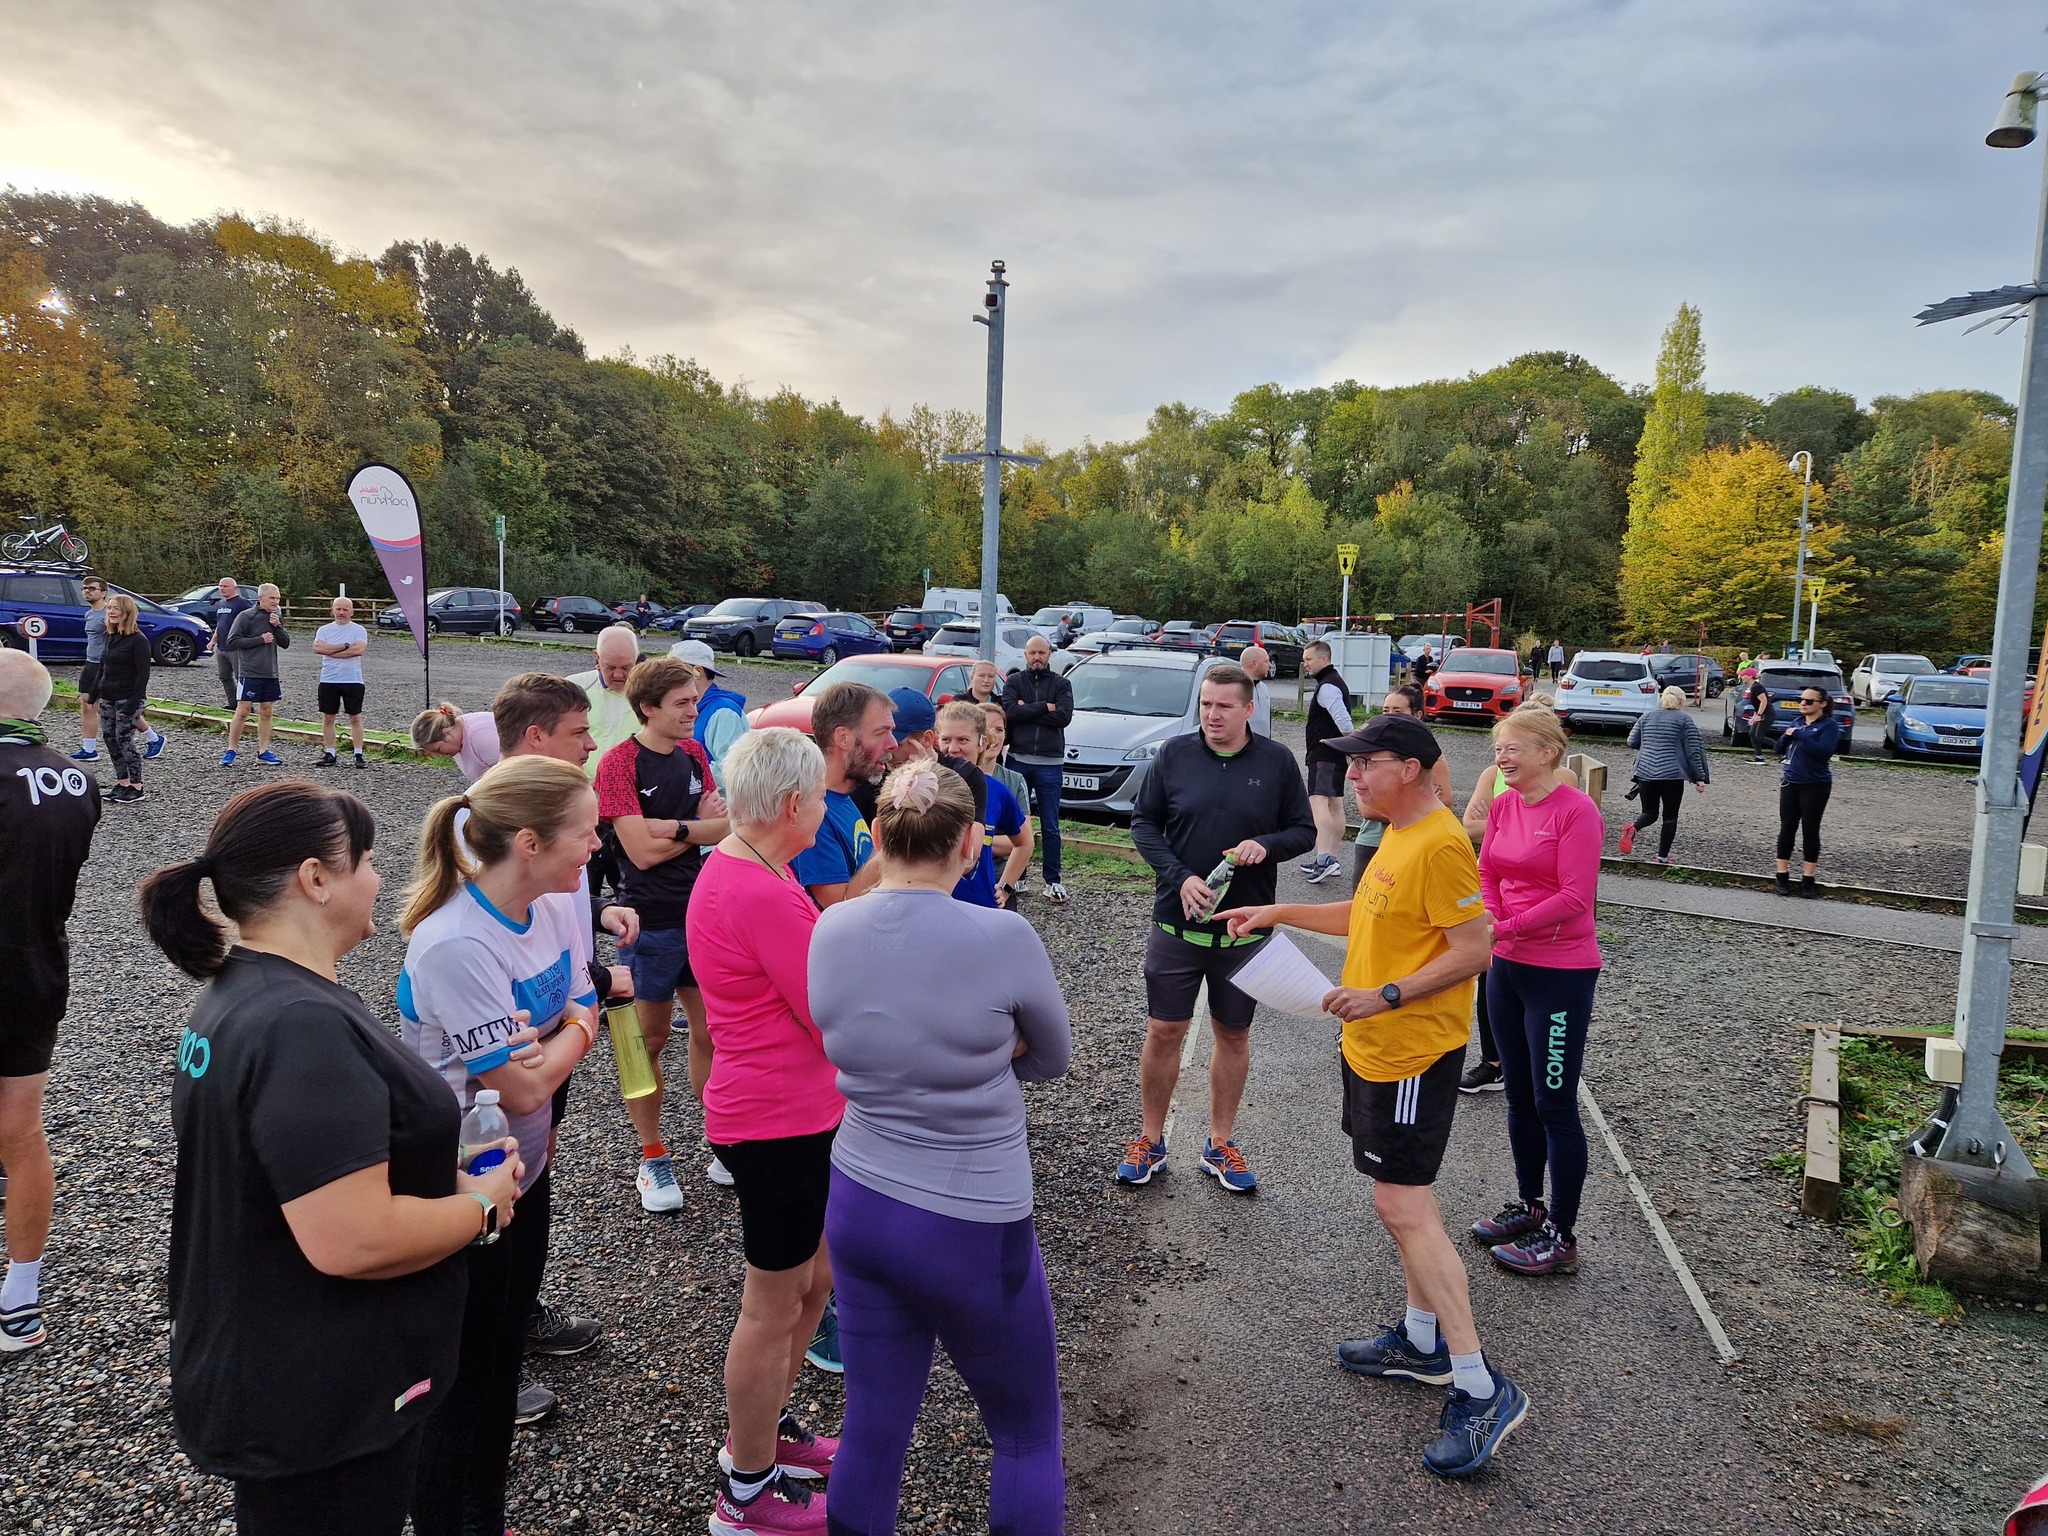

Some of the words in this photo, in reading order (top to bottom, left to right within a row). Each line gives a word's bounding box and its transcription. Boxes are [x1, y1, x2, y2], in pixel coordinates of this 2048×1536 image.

[30, 620, 41, 633] 5
[16, 767, 88, 806] 100
[1073, 777, 1093, 788] VLO
[535, 963, 560, 987] more
[720, 1499, 745, 1522] HOKA
